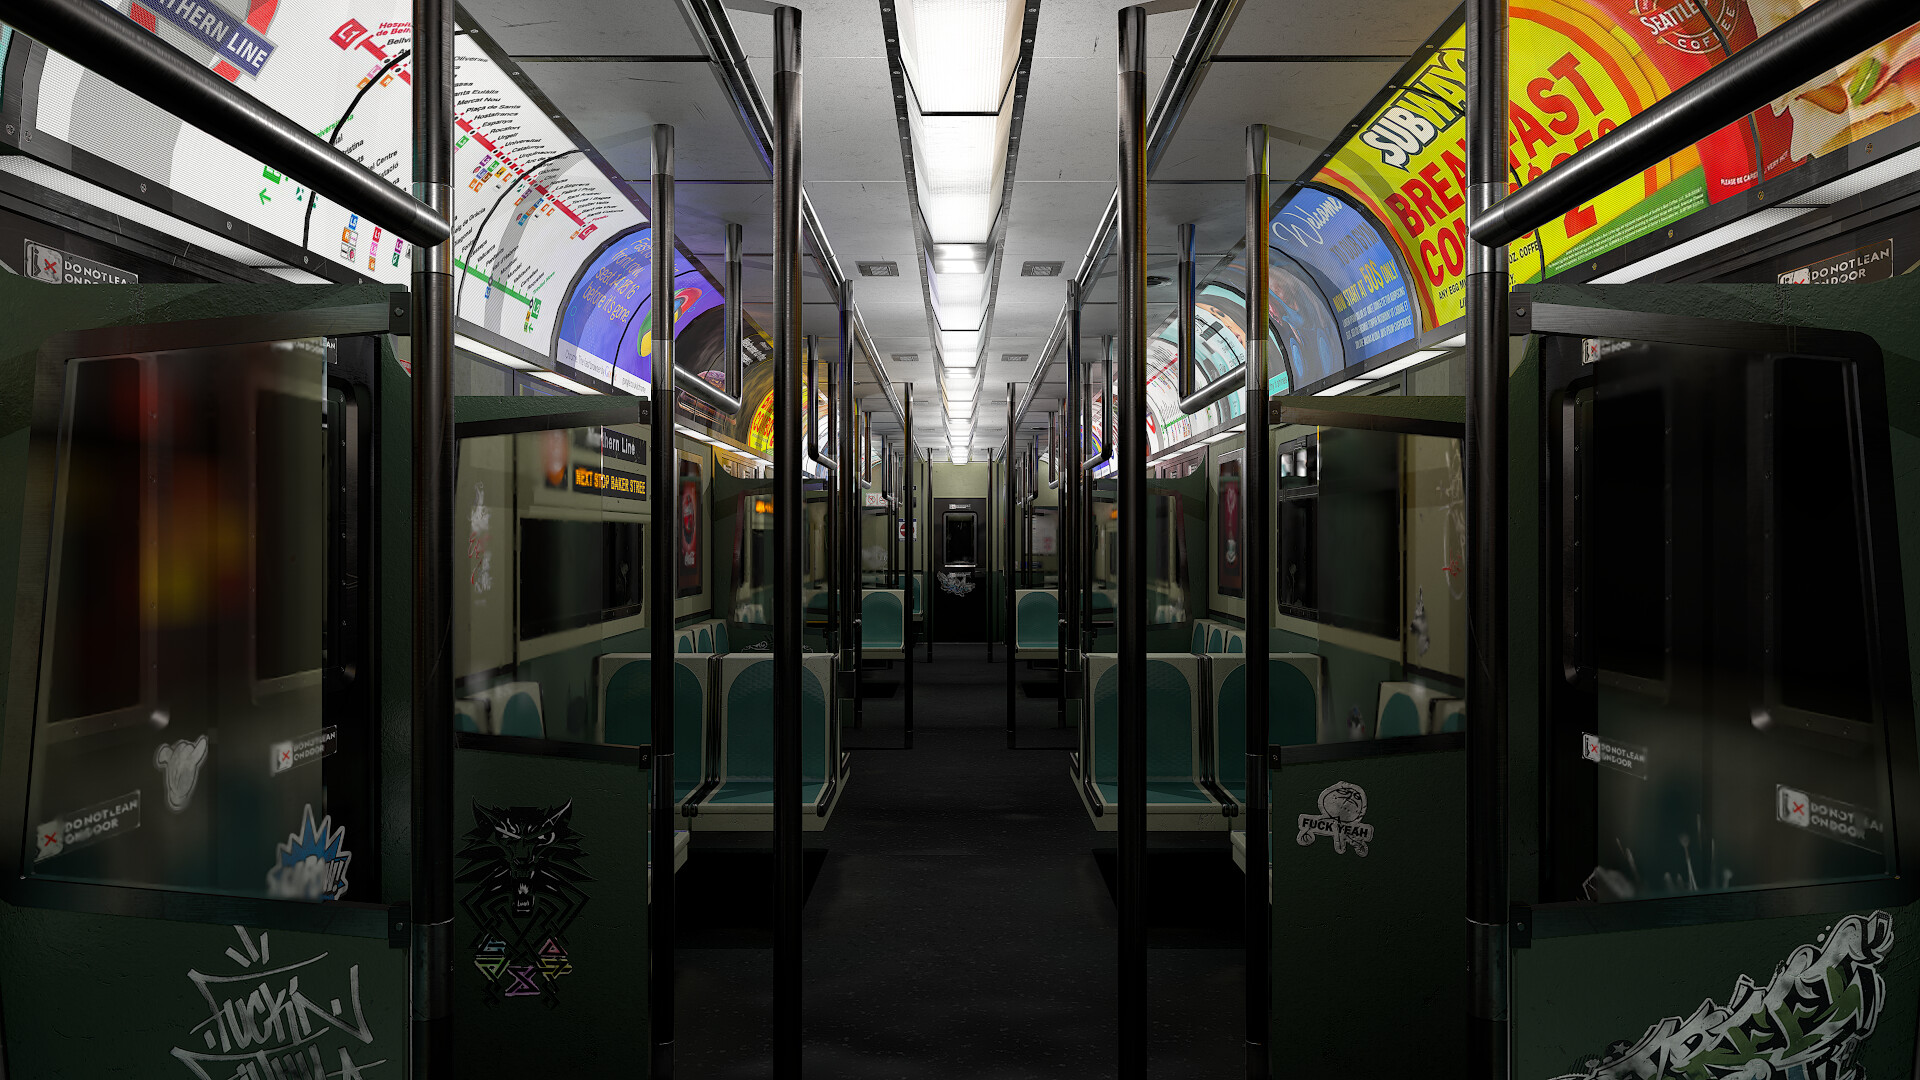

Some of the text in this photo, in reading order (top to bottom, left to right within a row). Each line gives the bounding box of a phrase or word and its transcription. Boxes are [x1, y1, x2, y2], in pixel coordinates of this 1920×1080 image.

[227, 32, 268, 68] LINE
[457, 97, 484, 106] Mercat
[482, 119, 513, 127] Espanya
[489, 126, 521, 134] Rocafort
[342, 140, 364, 155] ristina
[376, 150, 398, 166] Centre
[379, 162, 399, 177] stació
[1720, 178, 1737, 186] PLEASE
[1737, 176, 1743, 184] BE
[1271, 196, 1343, 247] Welcome
[612, 247, 636, 269] front
[1811, 247, 1890, 281] DO NOT LEAN
[64, 260, 82, 274] DO
[83, 266, 108, 282] NOT
[596, 267, 618, 286] seat
[1359, 258, 1384, 294] 50$
[1438, 288, 1449, 299] ANY
[1449, 282, 1459, 295] EGG
[1519, 240, 1540, 258] COFFE
[1830, 268, 1867, 285] DOOR
[64, 273, 82, 285] ON
[583, 281, 607, 309] before
[621, 437, 636, 455] Line
[575, 467, 593, 487] NEXT
[594, 472, 610, 489] STOP
[611, 476, 629, 492] BAKER
[1611, 746, 1627, 757] NOT
[64, 800, 138, 833] DO NOT LEAN
[1811, 802, 1828, 815] DO
[1302, 817, 1369, 838] FUCK YEAH
[1811, 815, 1828, 827] ON
